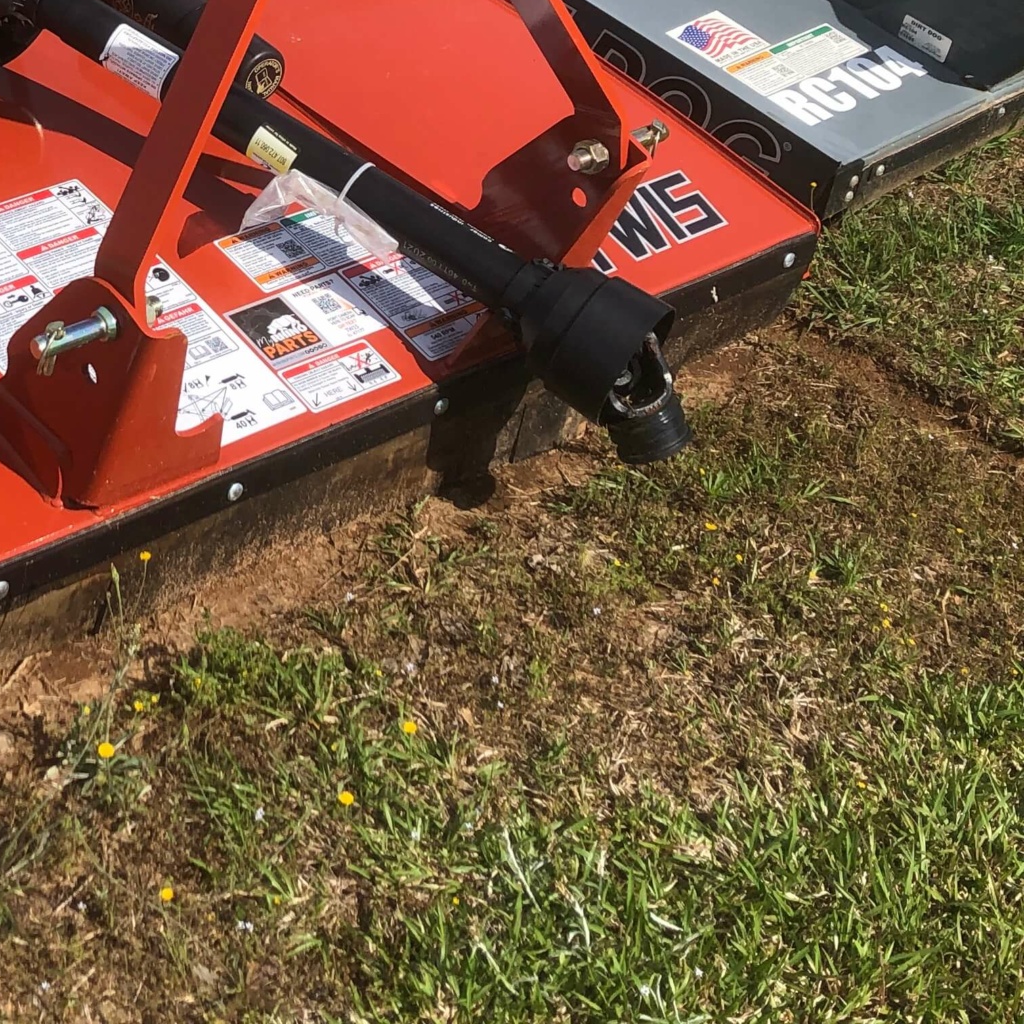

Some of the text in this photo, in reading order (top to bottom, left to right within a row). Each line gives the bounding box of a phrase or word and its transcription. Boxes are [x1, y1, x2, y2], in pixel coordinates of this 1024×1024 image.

[767, 45, 928, 126] RC104
[3, 195, 35, 210] DANGER
[47, 234, 78, 248] DANGER
[276, 261, 308, 276] WARNING
[292, 278, 334, 298] NEED PARTS?
[163, 305, 195, 321] GEFAHR
[263, 330, 319, 360] PARTS
